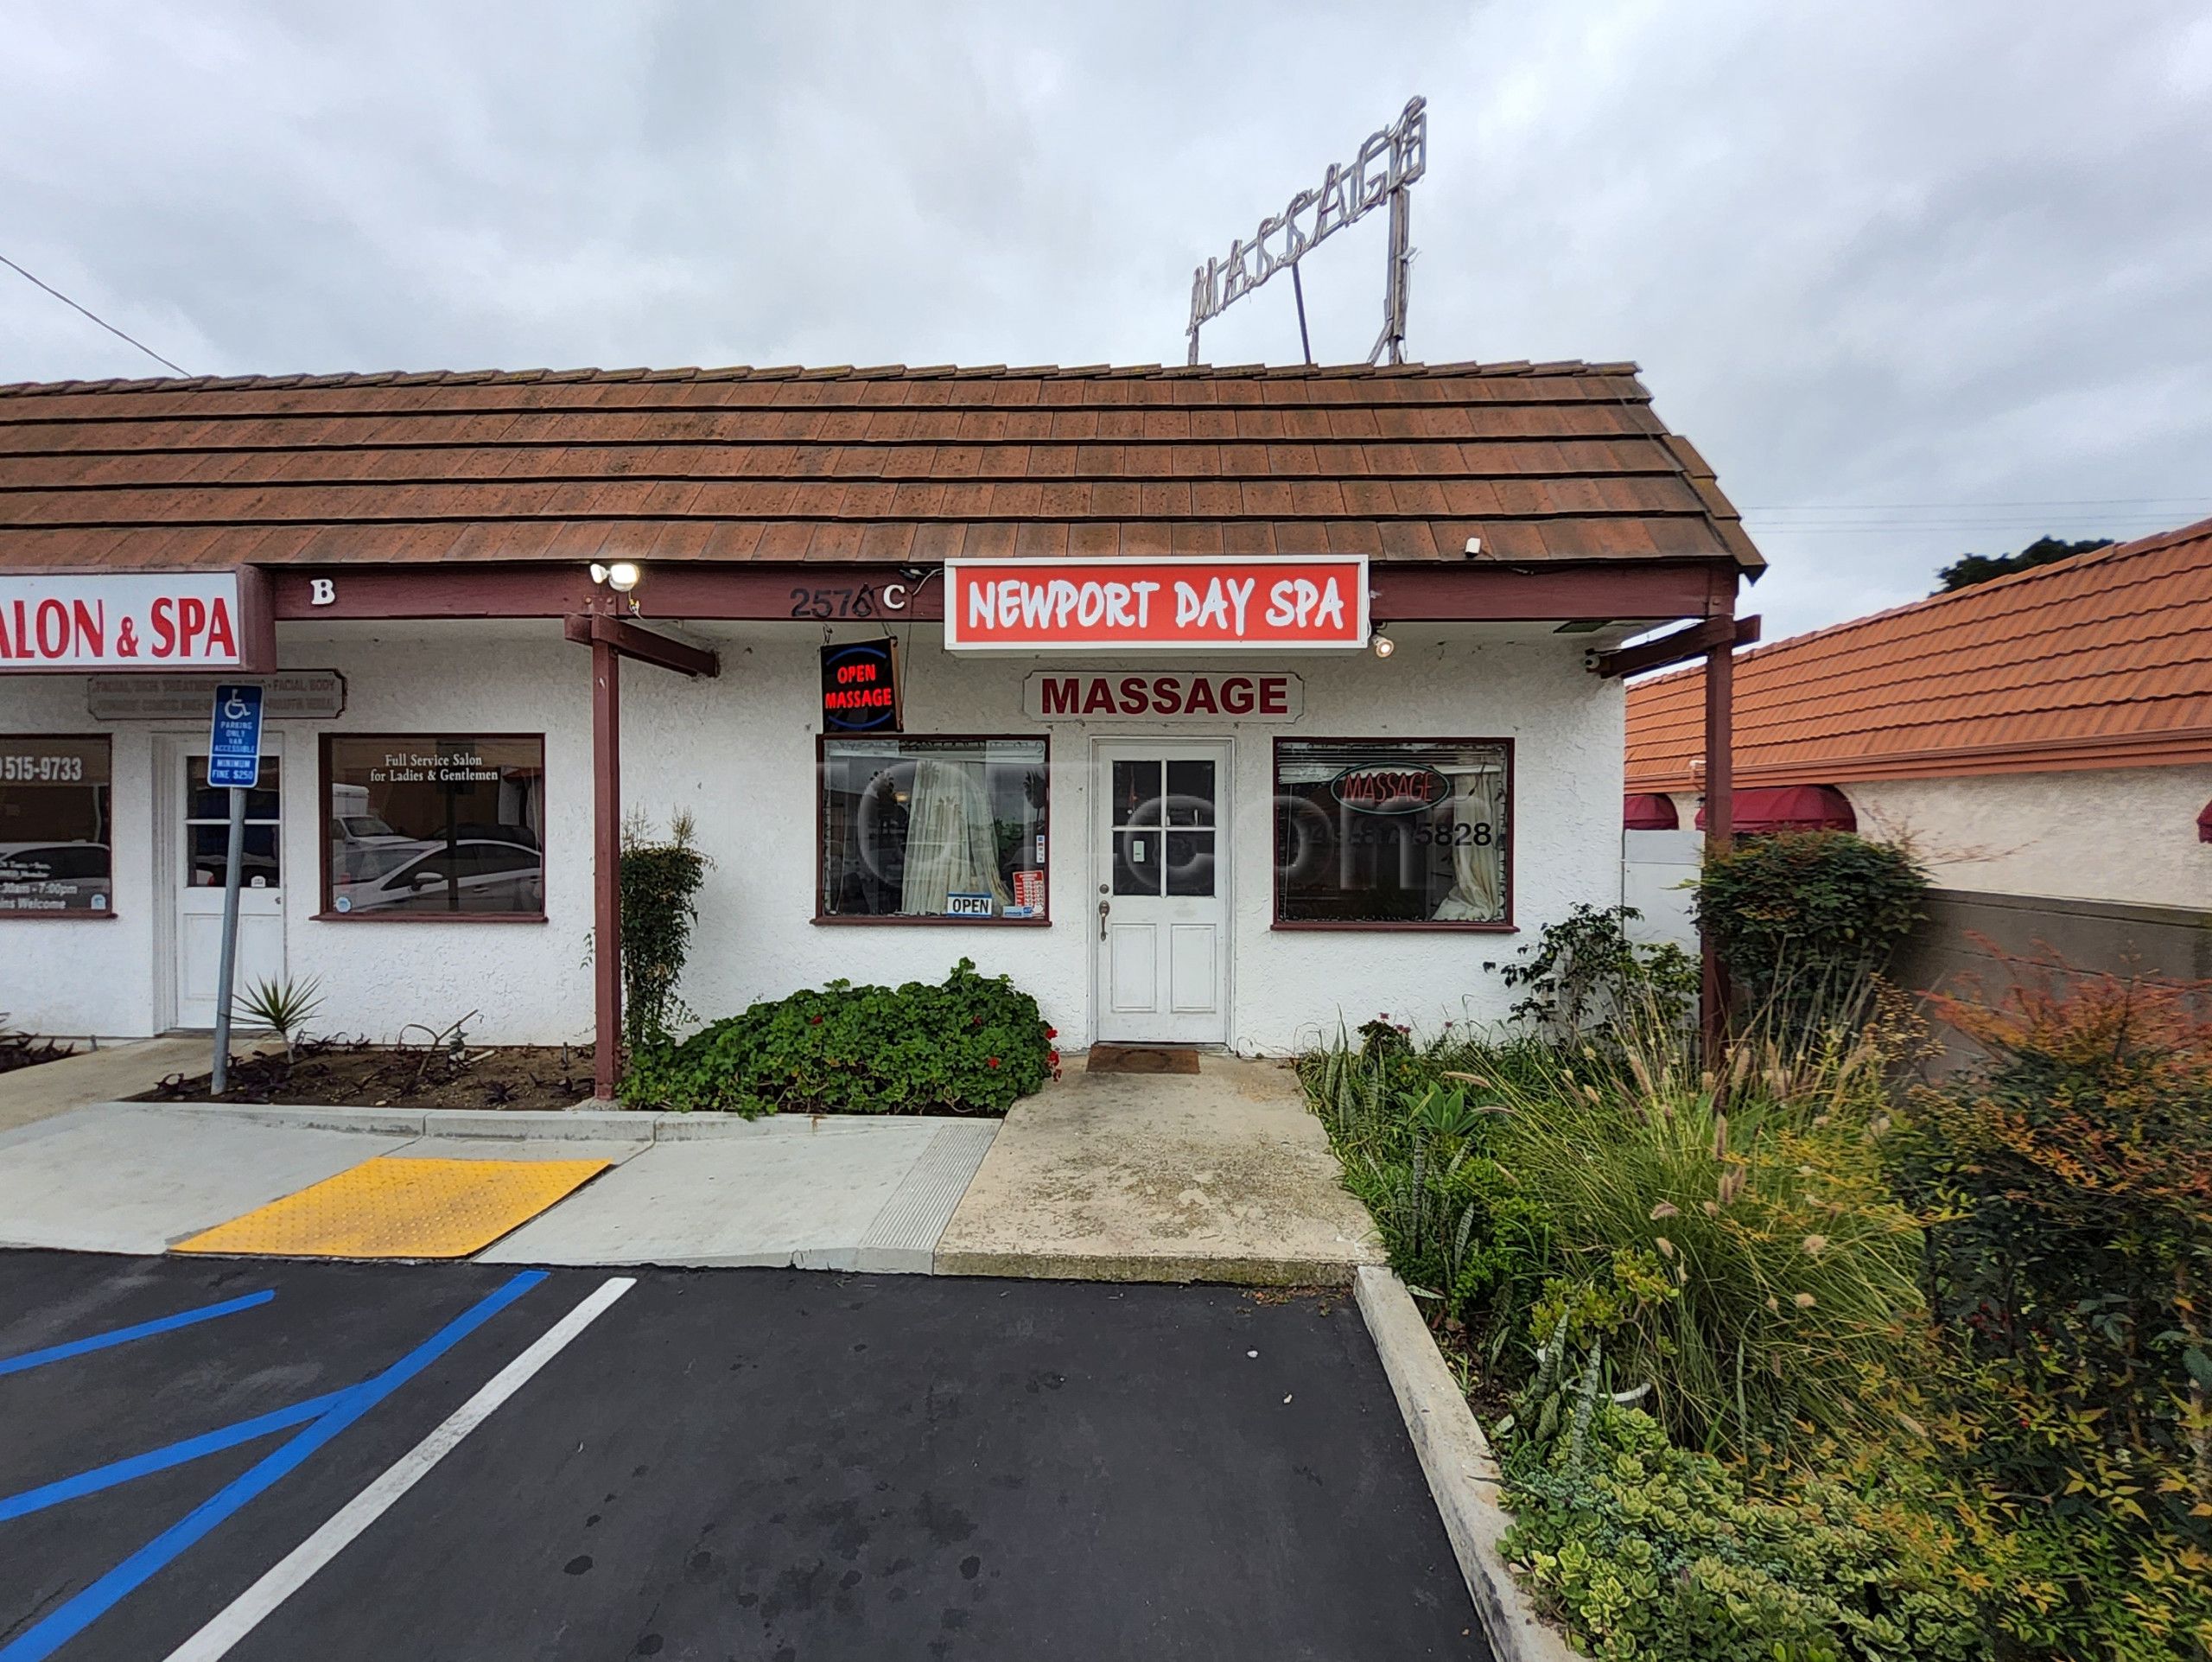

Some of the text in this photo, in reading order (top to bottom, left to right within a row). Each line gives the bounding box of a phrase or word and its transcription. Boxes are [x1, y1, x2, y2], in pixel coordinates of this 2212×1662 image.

[1191, 95, 1427, 322] MASSAGE
[310, 578, 335, 606] B
[883, 584, 906, 609] C
[969, 577, 1344, 636] NEWPORT DAY SPA
[116, 616, 139, 658] &
[150, 597, 238, 658] SPA
[837, 665, 876, 685] OPEN
[825, 688, 892, 710] MASSAGE
[1041, 677, 1288, 715] MASSAGE
[217, 759, 251, 768] MINIMUM
[385, 753, 482, 767] Full Service Salon
[212, 769, 230, 780] FINE
[371, 768, 499, 782] for Ladies & Gentlemen
[1343, 771, 1434, 803] MASSAGE
[952, 899, 988, 914] OPEN
